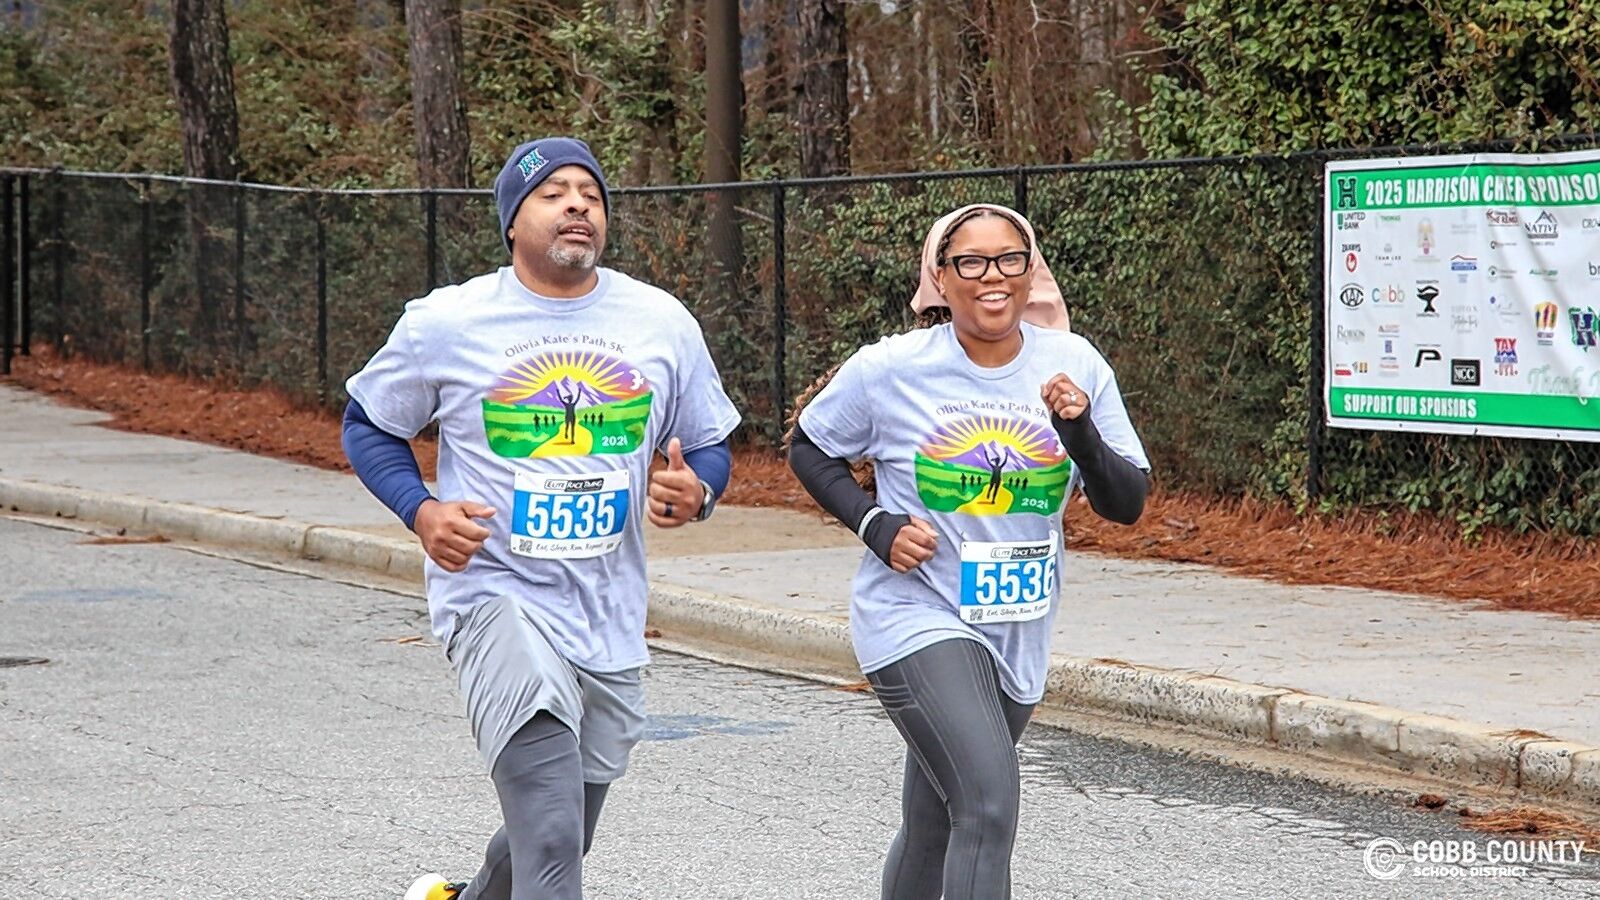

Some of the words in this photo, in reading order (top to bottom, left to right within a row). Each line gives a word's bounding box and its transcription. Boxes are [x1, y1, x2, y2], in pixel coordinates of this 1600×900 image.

[1366, 179, 1402, 206] 2025
[1406, 175, 1480, 205] HARRISON
[1527, 172, 1600, 203] SPONSO
[1344, 212, 1366, 221] UNITED
[1344, 222, 1359, 230] BANK
[1524, 222, 1558, 233] NATIVE
[504, 339, 540, 357] Olivia
[542, 335, 578, 345] Kate's
[582, 334, 607, 348] Path
[608, 341, 626, 354] 5K
[1494, 338, 1517, 352] TAX
[935, 402, 970, 416] Olivia
[971, 400, 1005, 410] Kate's
[1008, 402, 1031, 414] Path
[1344, 393, 1394, 414] SUPPORT
[1396, 395, 1417, 416] OUR
[1419, 396, 1478, 418] SPONSORS
[526, 491, 616, 539] 5535
[976, 555, 1056, 605] 5536
